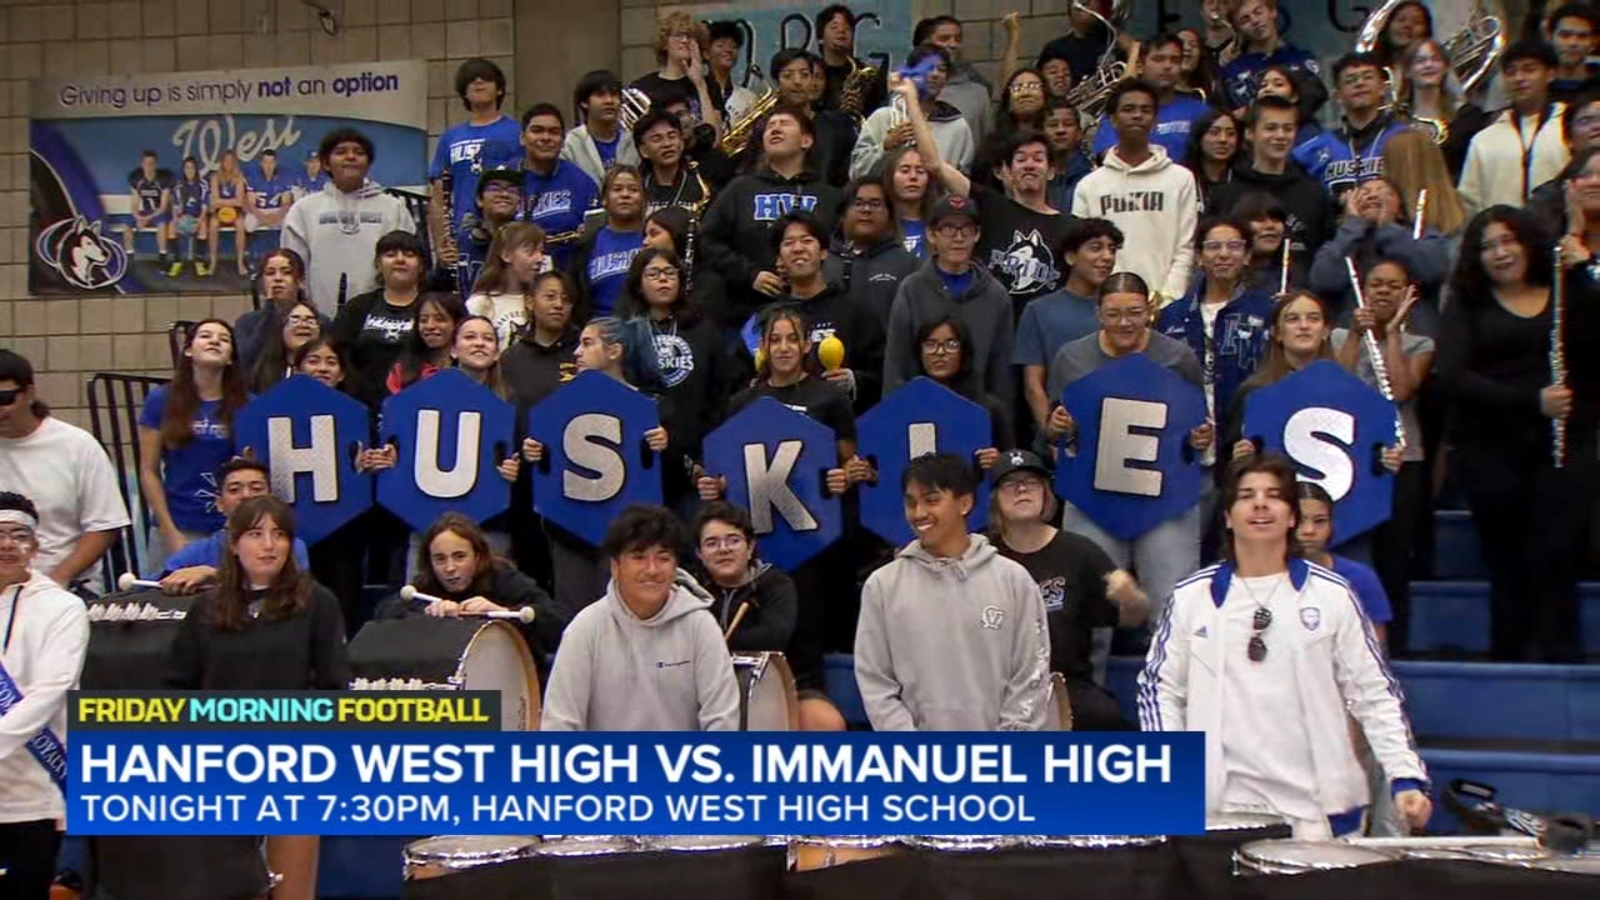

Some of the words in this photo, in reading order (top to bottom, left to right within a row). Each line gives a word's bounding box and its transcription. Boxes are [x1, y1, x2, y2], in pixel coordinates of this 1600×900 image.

[60, 85, 127, 108] Giving
[133, 86, 161, 106] up
[168, 83, 181, 100] is
[187, 79, 251, 102] simply
[258, 76, 292, 97] not
[298, 78, 325, 95] an
[333, 72, 399, 96] option
[658, 355, 694, 370] SKIES
[268, 415, 338, 502] H
[414, 410, 481, 497] U
[562, 414, 625, 501] S
[744, 441, 818, 534] K
[1094, 398, 1167, 496] E
